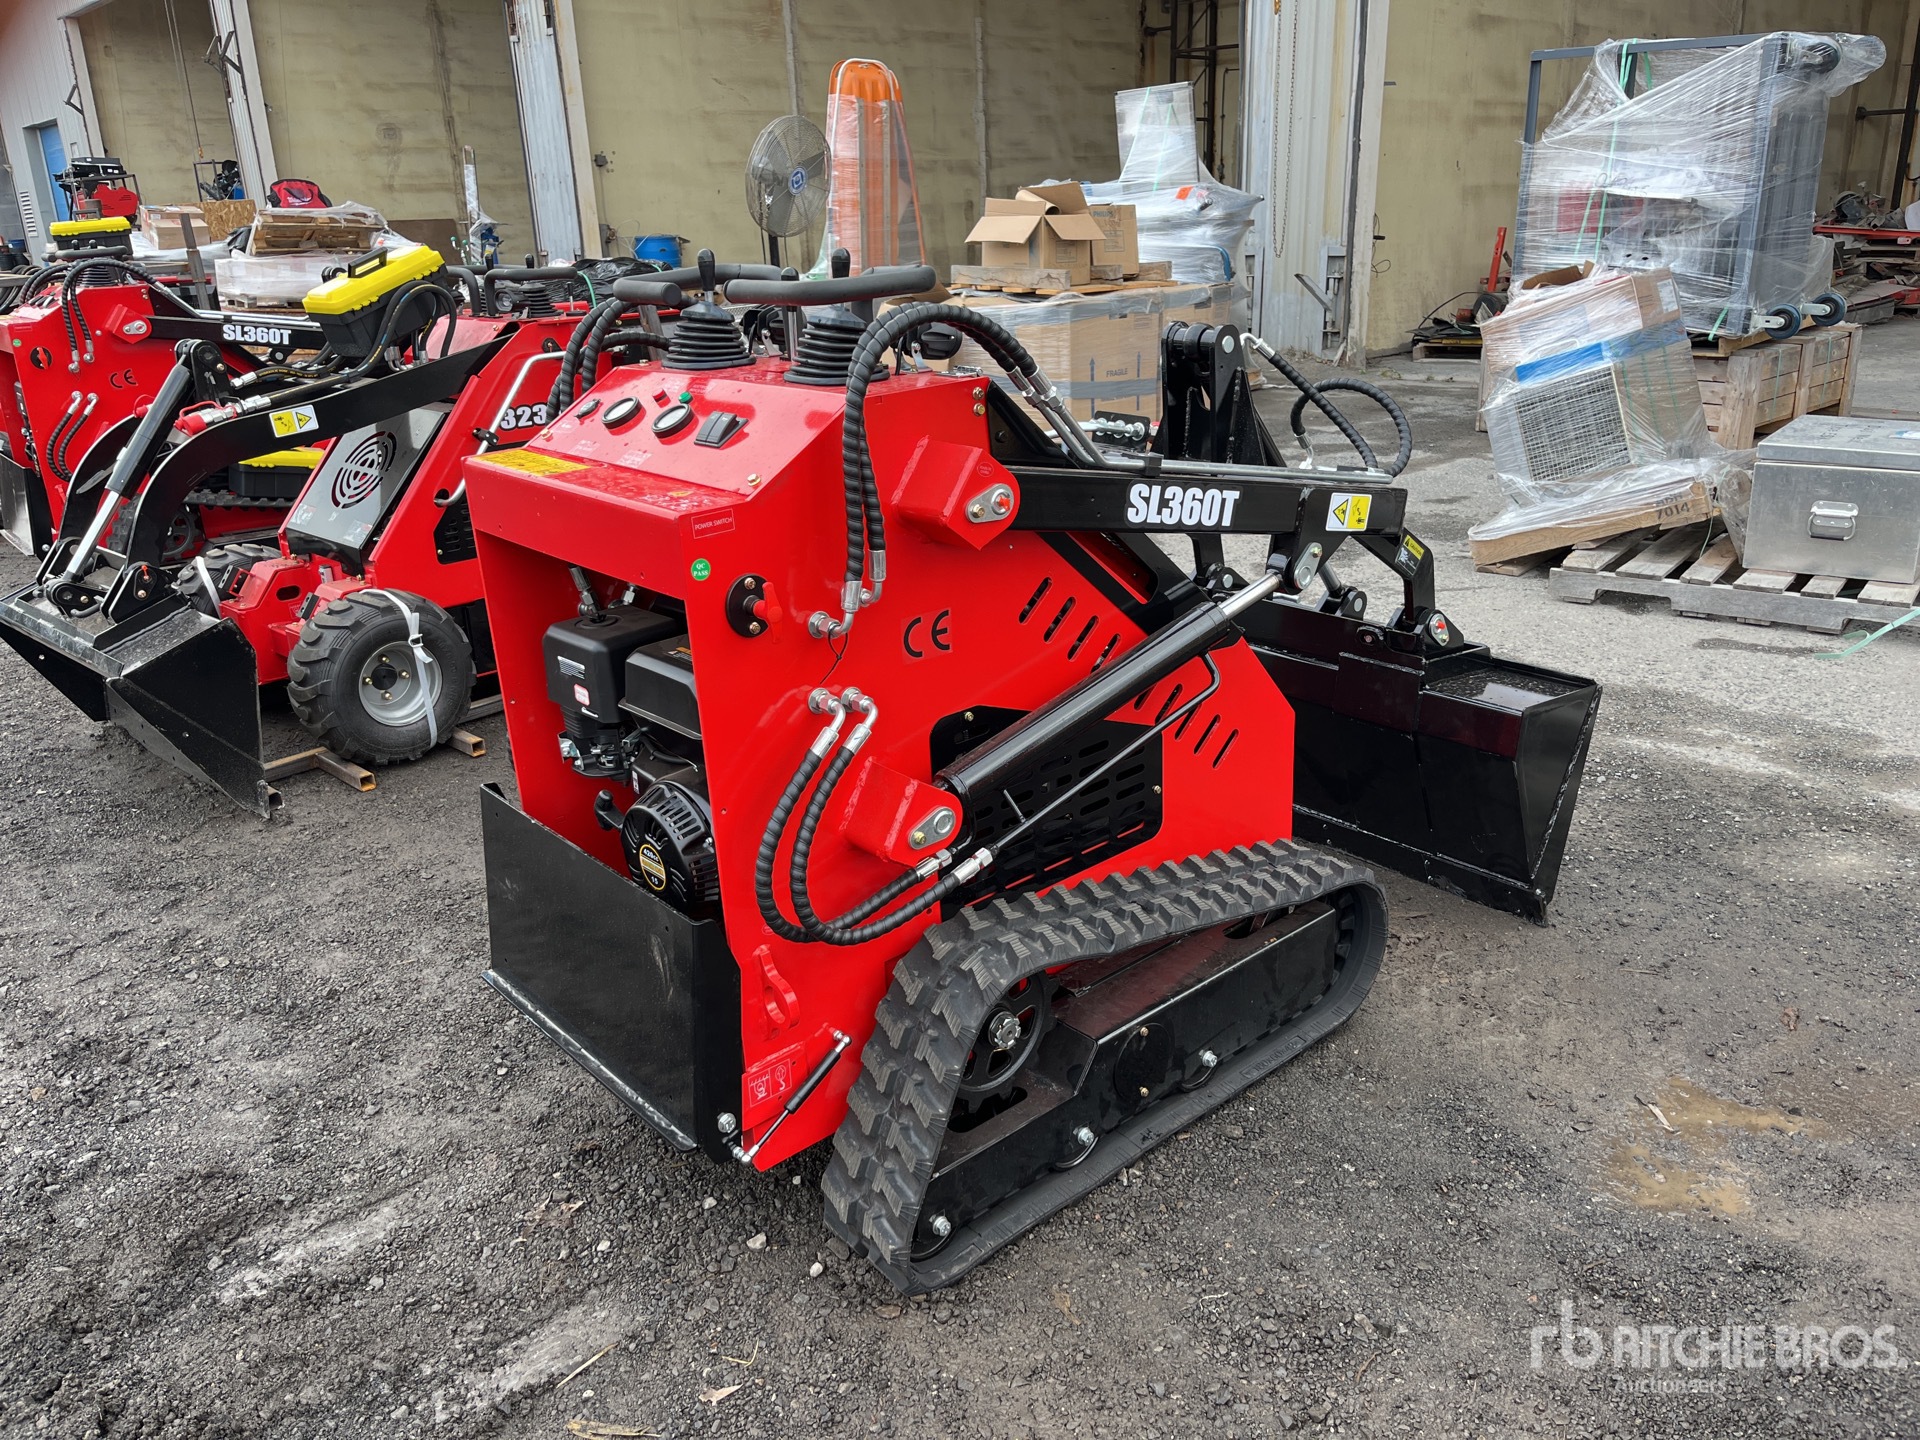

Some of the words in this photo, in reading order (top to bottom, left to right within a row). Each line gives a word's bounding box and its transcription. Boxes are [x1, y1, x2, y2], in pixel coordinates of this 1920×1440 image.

[222, 324, 292, 345] SL360T
[110, 369, 137, 388] CE
[1106, 367, 1128, 378] FRAGILE
[1127, 483, 1240, 527] SL360T
[1657, 502, 1690, 519] 7014
[694, 521, 713, 530] POWER
[713, 517, 733, 526] SWITCH
[696, 562, 706, 570] QC
[903, 609, 950, 658] CE
